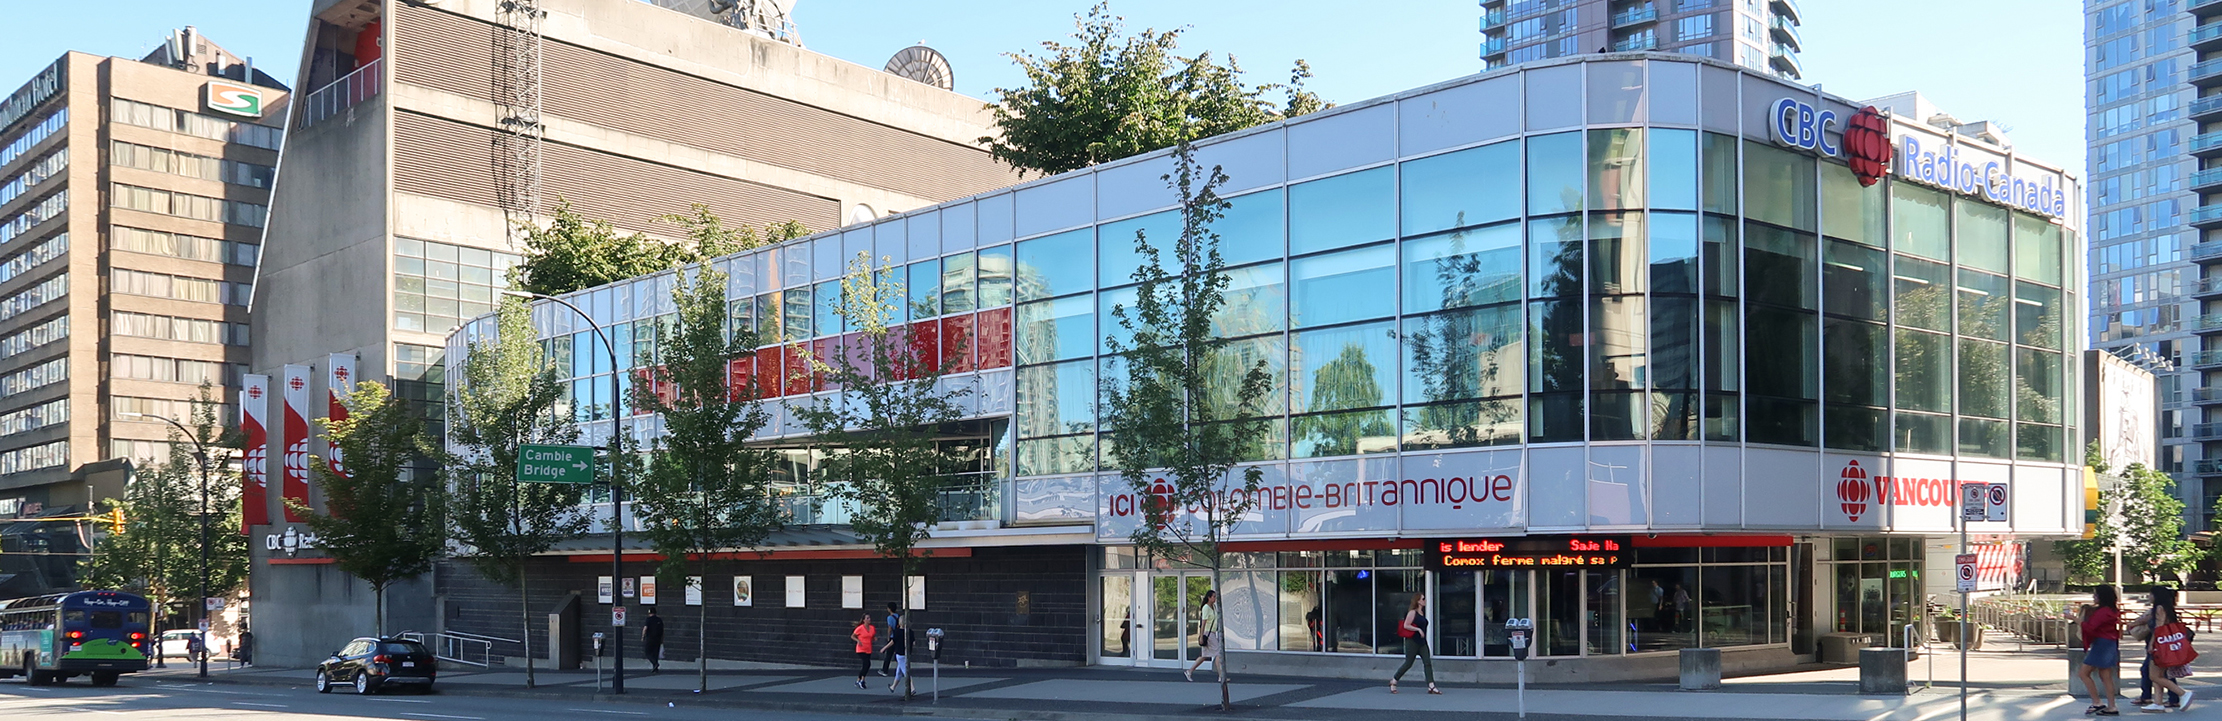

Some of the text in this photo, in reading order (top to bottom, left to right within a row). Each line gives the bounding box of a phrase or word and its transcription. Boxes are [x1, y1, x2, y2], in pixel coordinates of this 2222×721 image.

[33, 62, 58, 107] Hotel
[1770, 97, 2066, 218] CBC Radio-Canada
[525, 449, 573, 462] Cambie
[524, 464, 566, 479] Bridge
[1109, 494, 1135, 517] ICI
[266, 534, 282, 550] CBC
[1440, 542, 1452, 552] is
[1457, 540, 1504, 552] lender
[1570, 539, 1600, 551] Saje
[1443, 555, 1485, 566] Comox
[1492, 554, 1535, 566] ferme
[1541, 554, 1585, 566] malgré
